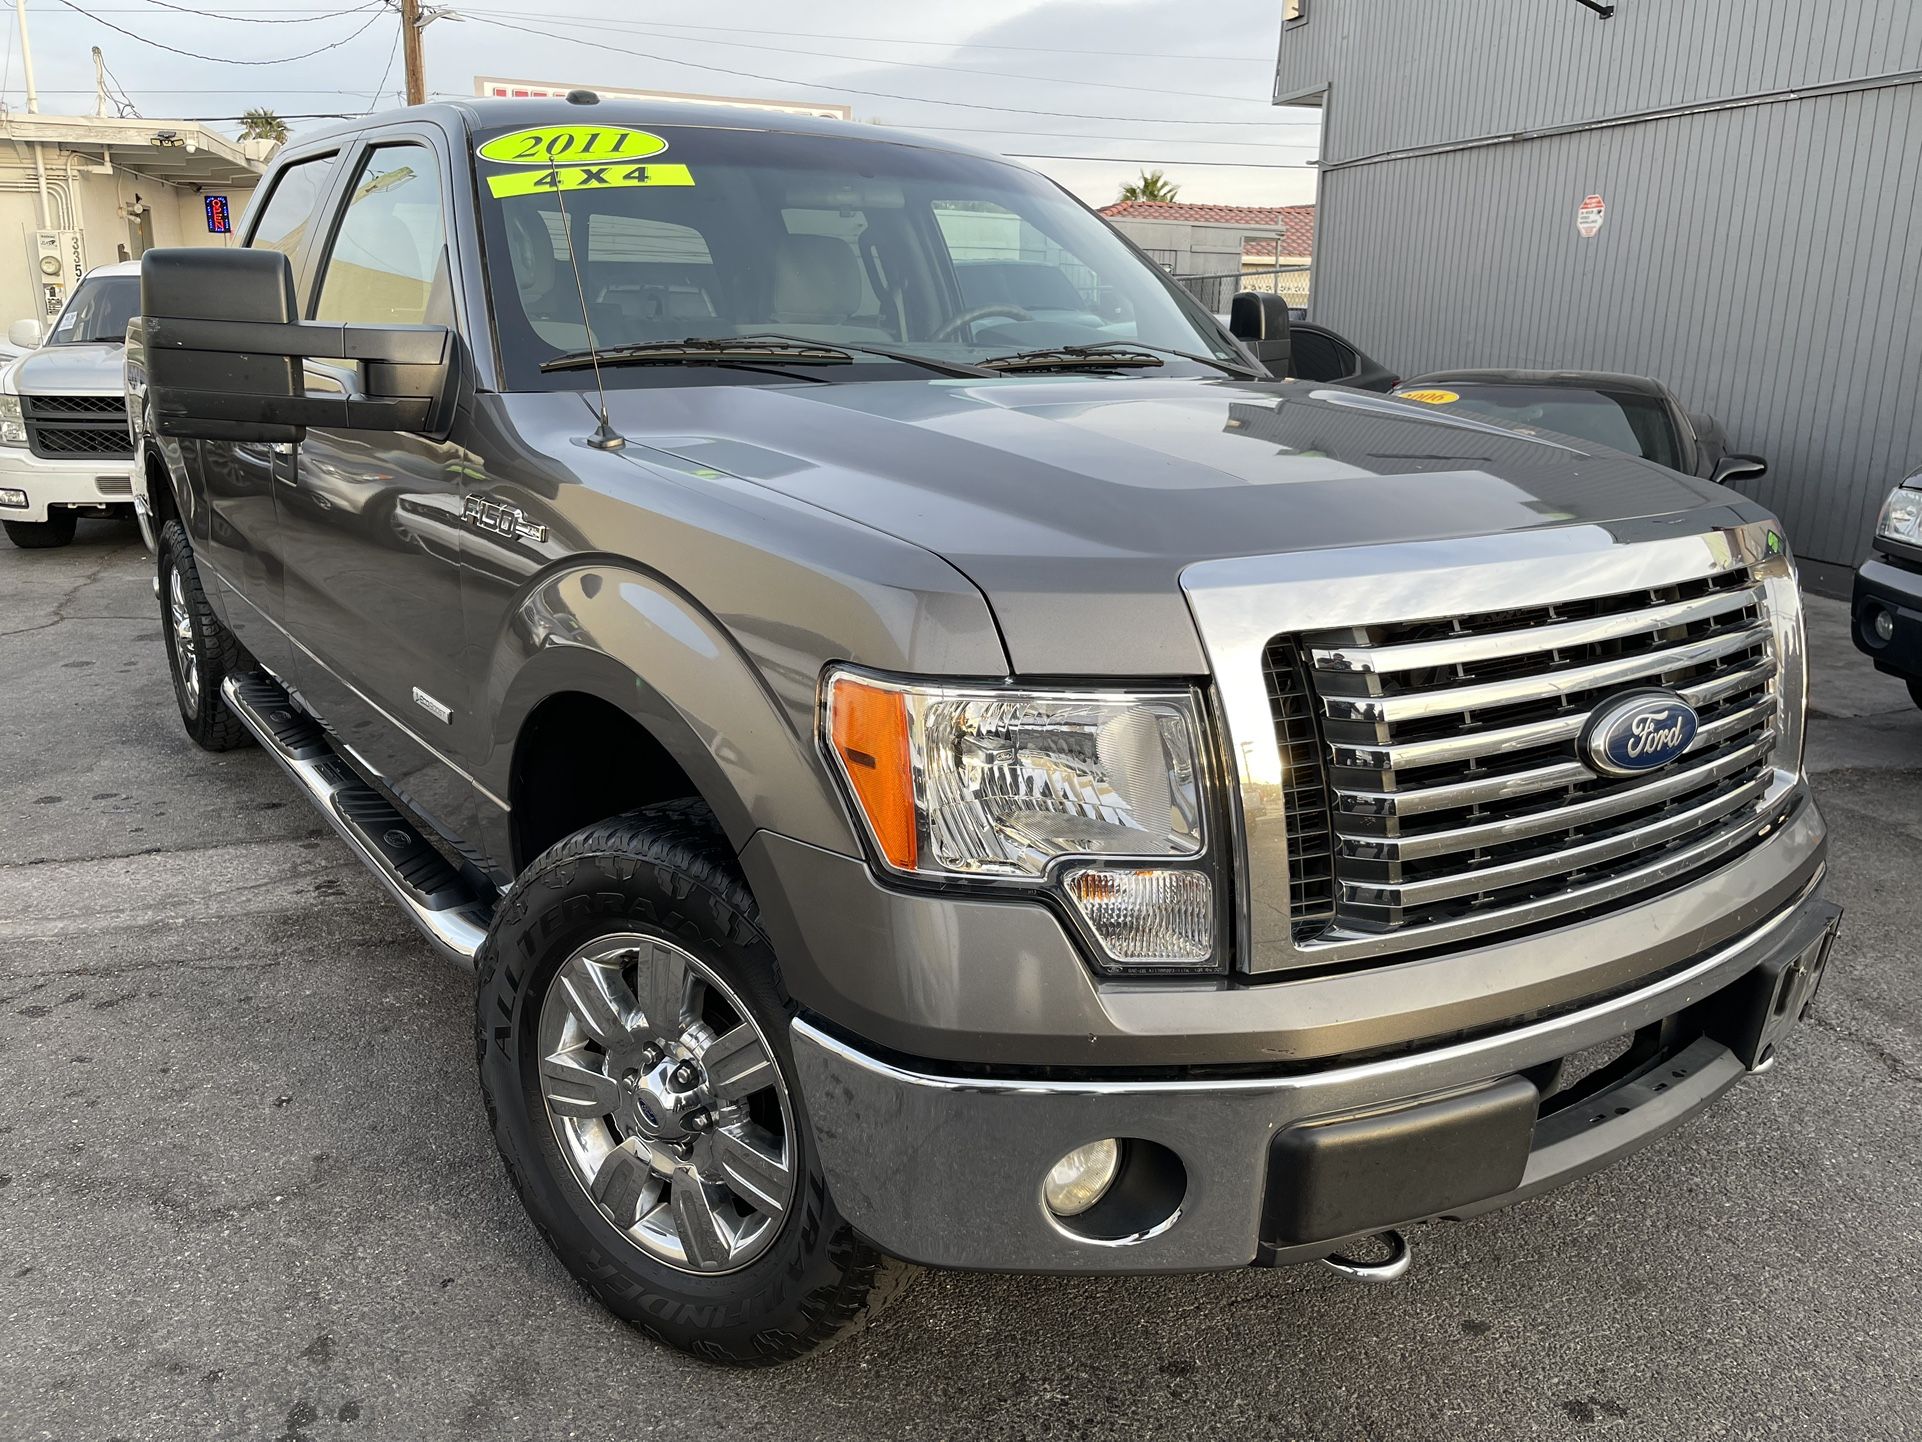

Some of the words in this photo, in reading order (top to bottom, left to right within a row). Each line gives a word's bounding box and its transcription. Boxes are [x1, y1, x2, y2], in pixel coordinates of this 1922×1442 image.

[512, 132, 631, 159] 2011
[71, 237, 83, 283] 335
[1627, 710, 1683, 759] Ford
